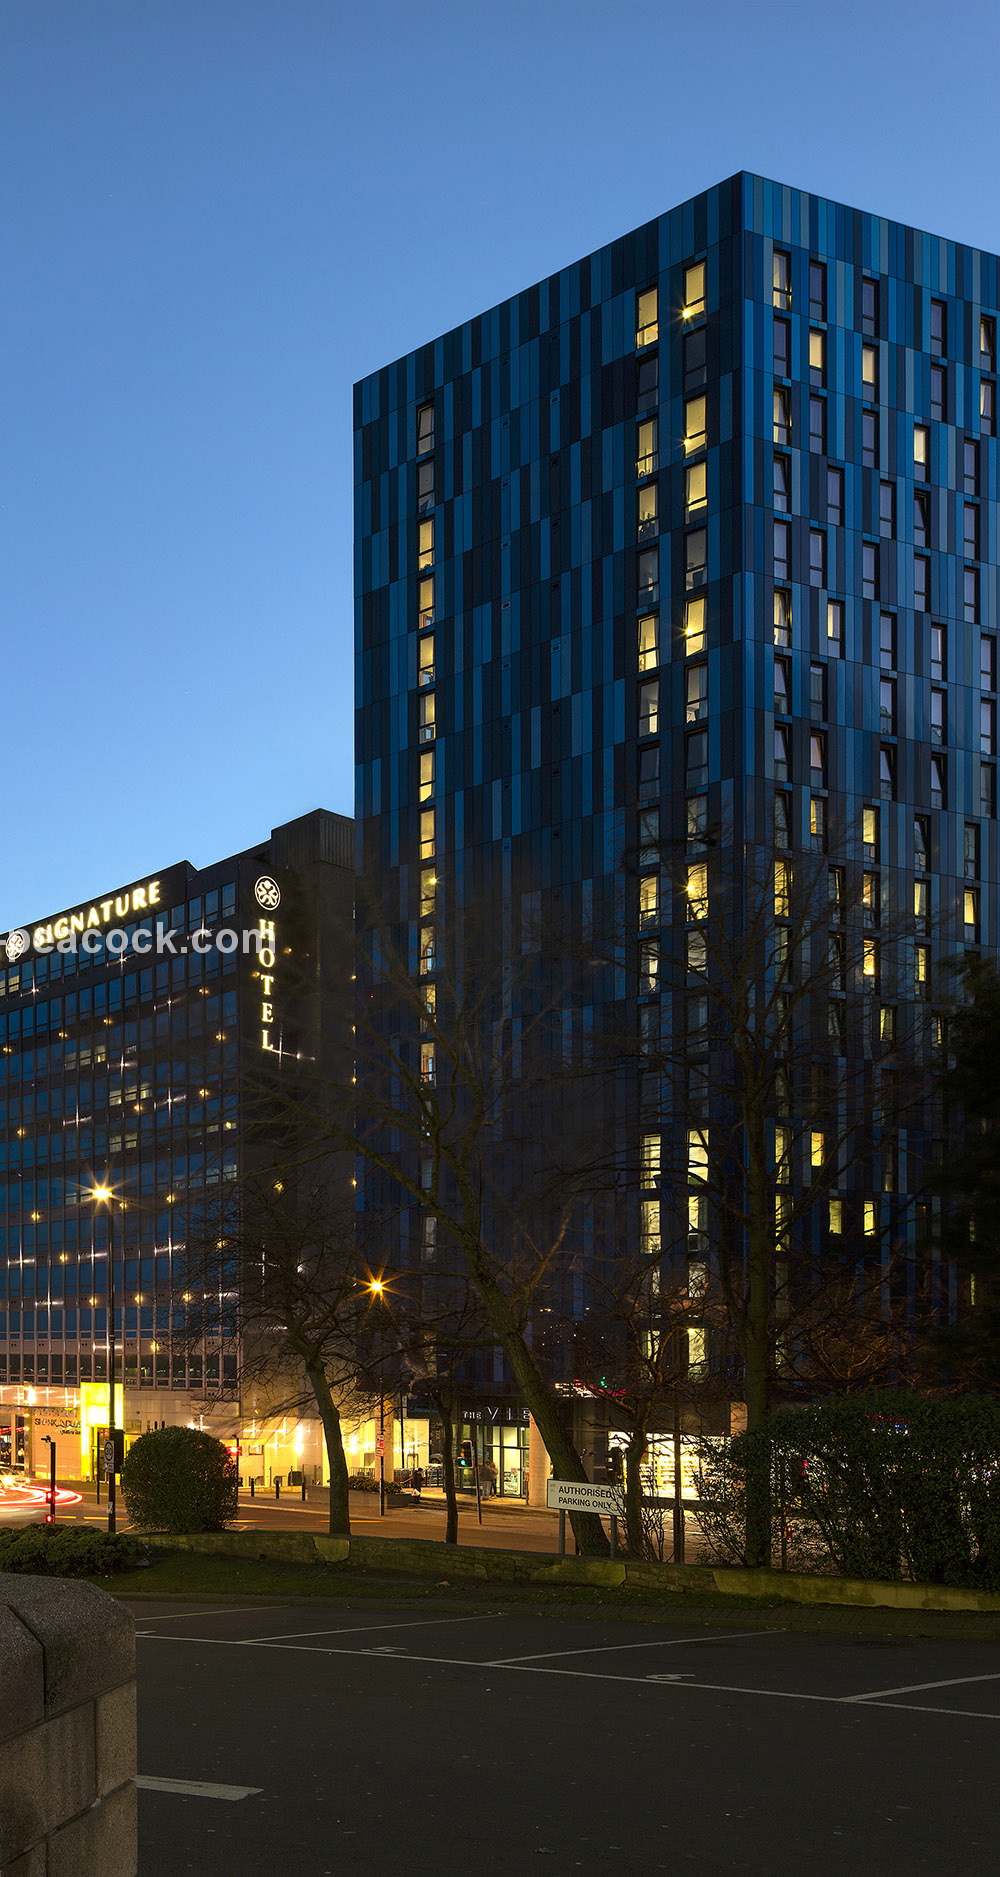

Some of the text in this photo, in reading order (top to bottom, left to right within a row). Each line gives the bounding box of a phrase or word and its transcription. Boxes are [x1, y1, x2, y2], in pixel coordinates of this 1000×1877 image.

[33, 880, 162, 948] SIGNATURE
[258, 918, 275, 1051] HOTEL
[462, 1410, 482, 1420] THE
[558, 1485, 612, 1499] AUTHORISED
[558, 1496, 613, 1509] PARKING ONLY
